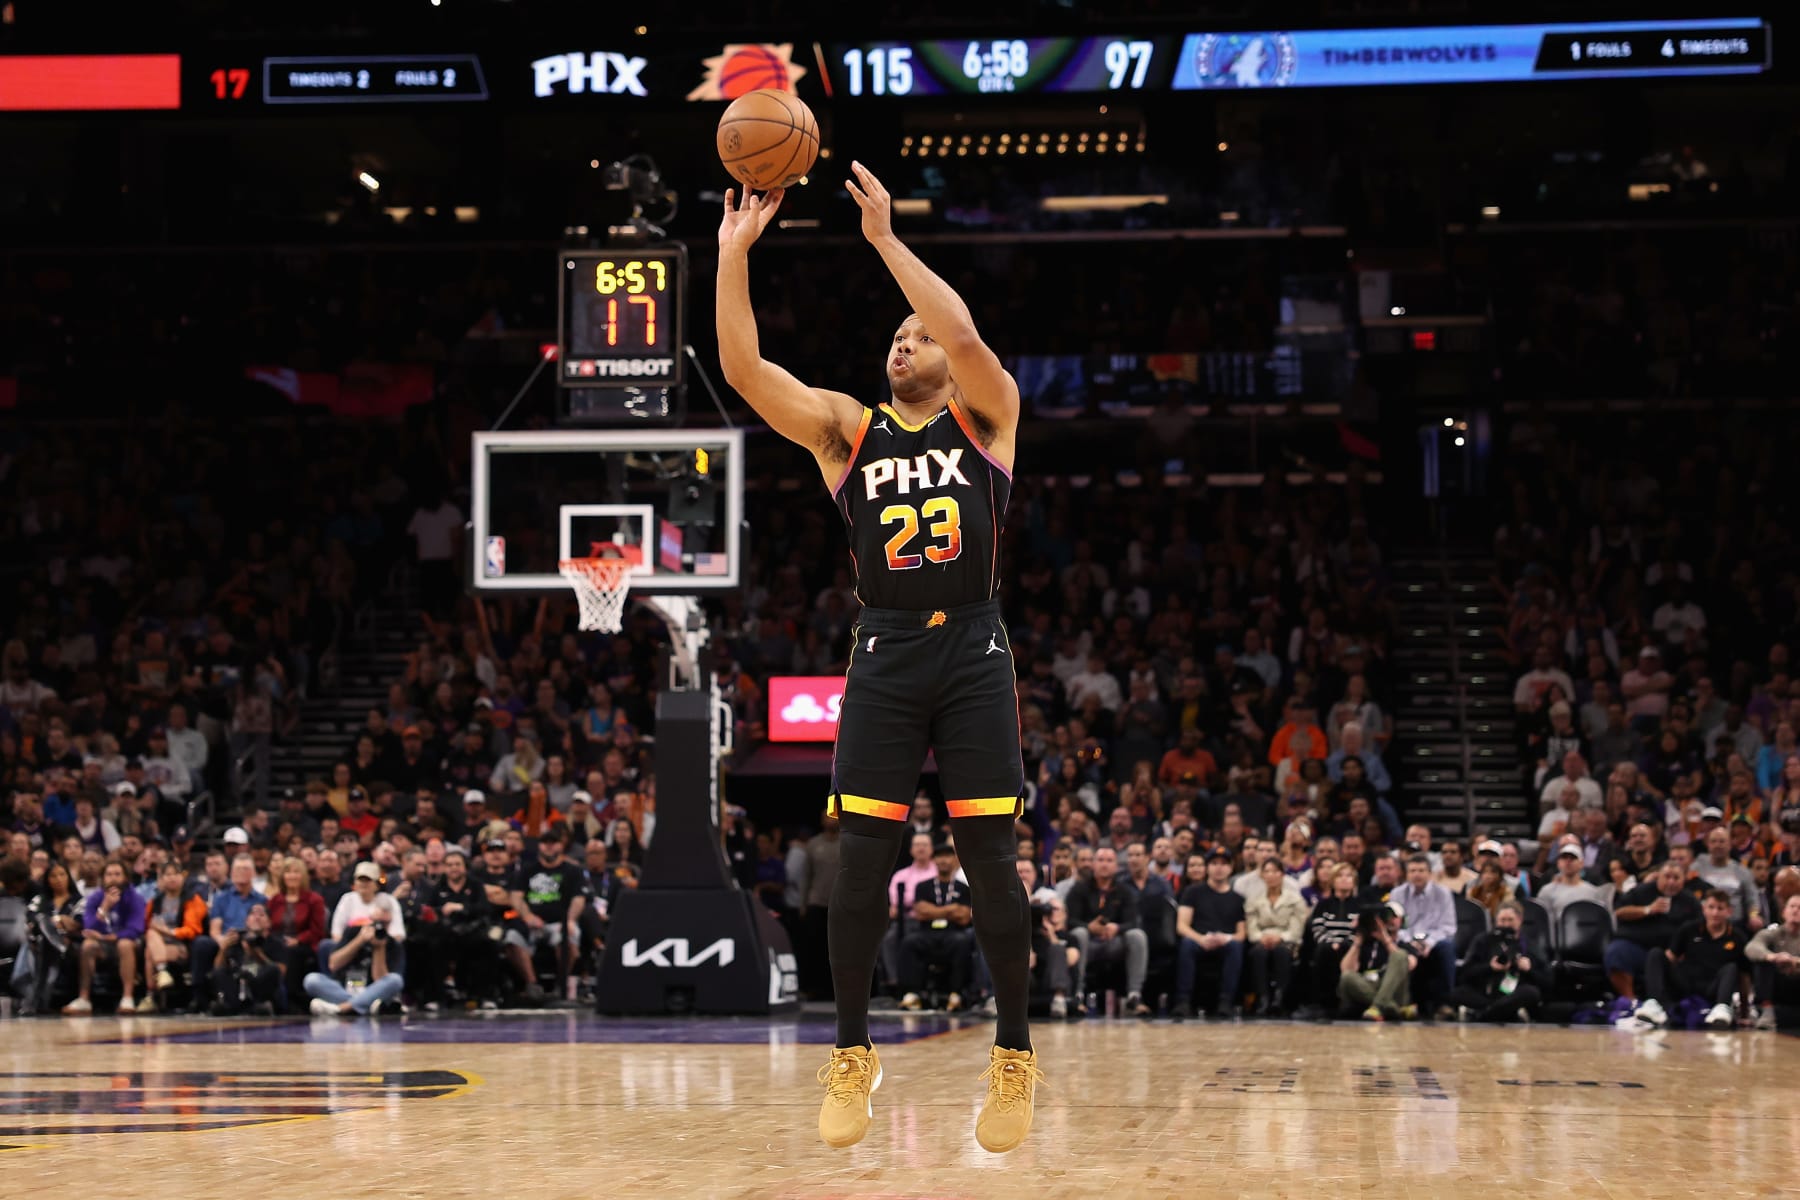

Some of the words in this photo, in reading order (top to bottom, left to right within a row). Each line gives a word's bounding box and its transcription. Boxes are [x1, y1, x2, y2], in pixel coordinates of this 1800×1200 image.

[963, 40, 1028, 78] 6:58
[1323, 44, 1497, 65] TIMBERWOLVES
[1660, 39, 1675, 58] 4
[357, 69, 370, 88] 2
[443, 69, 456, 87] 2
[531, 52, 647, 97] PHX
[843, 48, 913, 95] 115
[1105, 42, 1153, 89] 97
[211, 69, 249, 98] 17
[596, 261, 666, 294] 6:57
[607, 295, 656, 346] 17
[596, 359, 673, 376] TISSOT
[861, 449, 972, 500] PHX
[880, 496, 962, 570] 23
[621, 938, 735, 967] KIA
